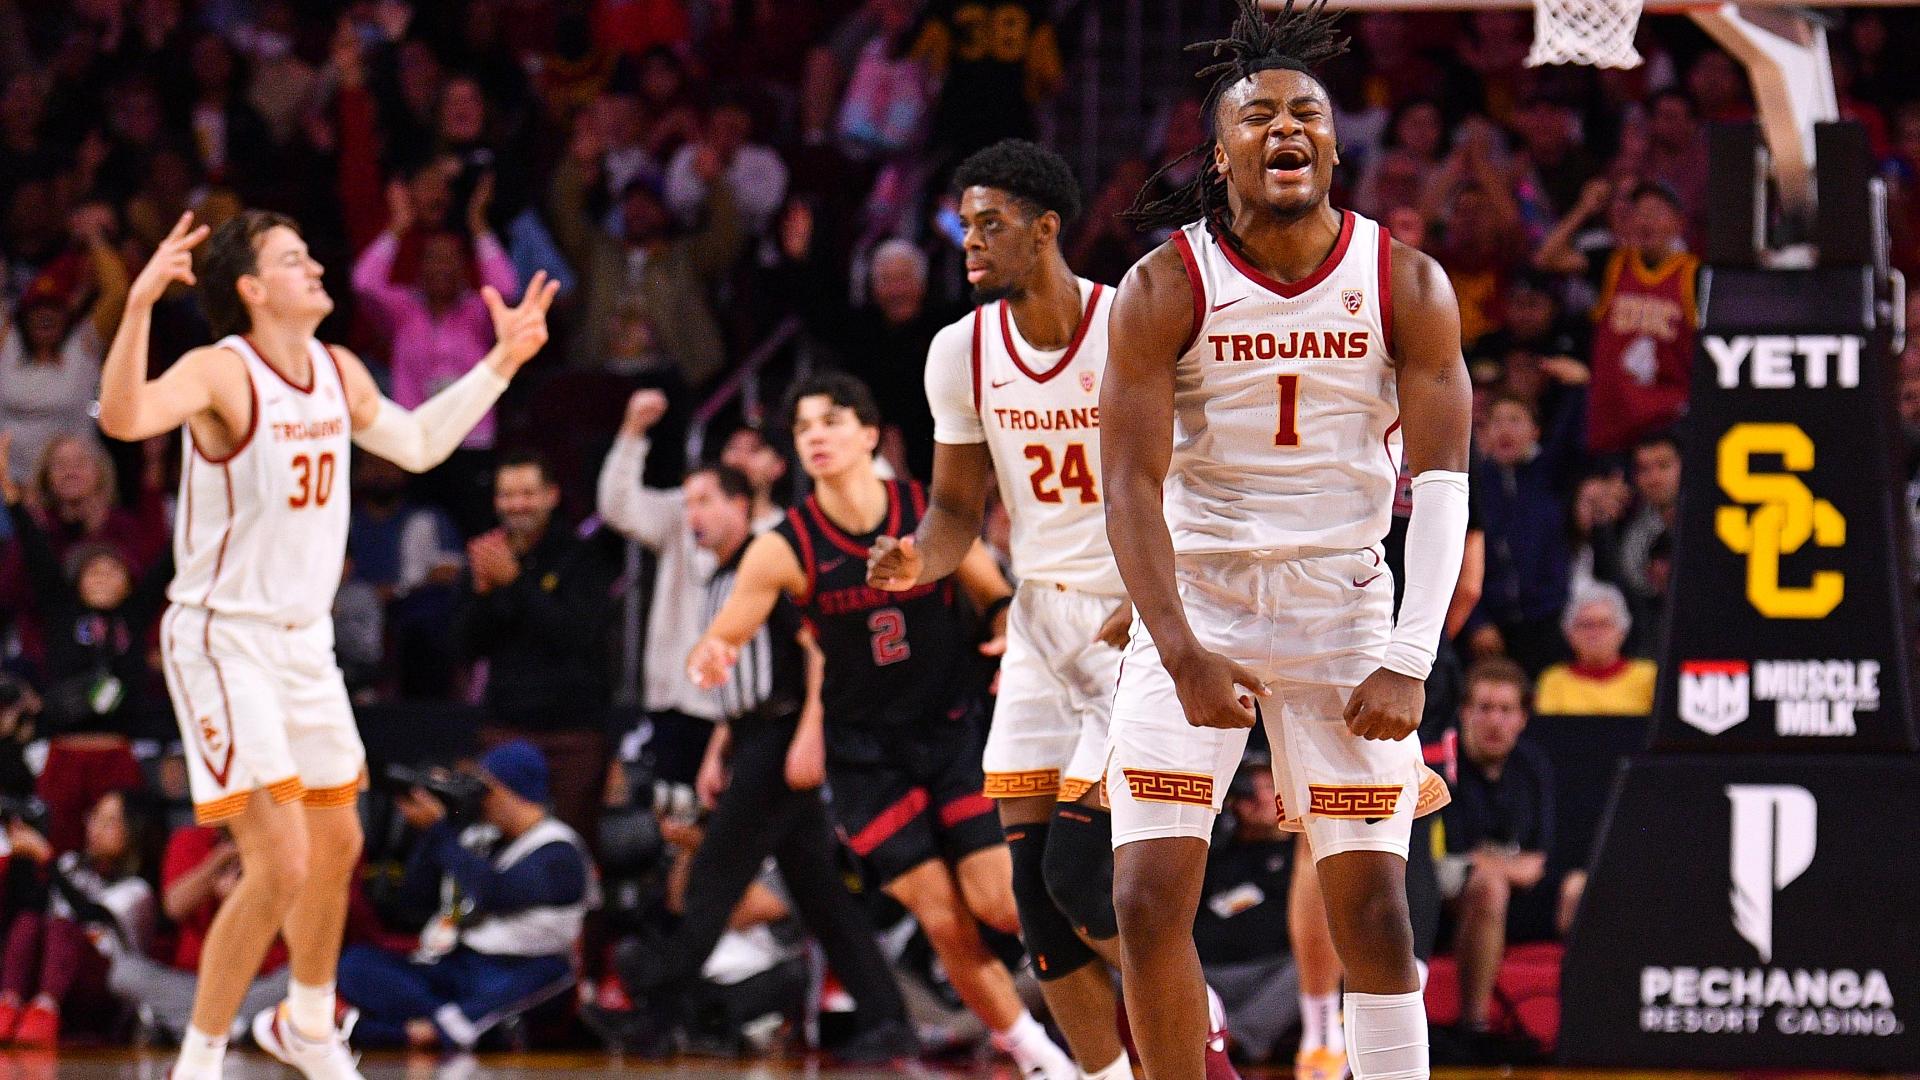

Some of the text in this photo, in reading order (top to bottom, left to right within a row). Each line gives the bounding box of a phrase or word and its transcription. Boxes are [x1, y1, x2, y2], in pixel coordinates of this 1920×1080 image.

[1208, 332, 1369, 361] TROJANS
[1702, 335, 1862, 389] YETI
[993, 407, 1100, 431] TROJANS
[1275, 374, 1300, 447] 1
[288, 452, 336, 508] 30
[1023, 443, 1099, 504] 24
[868, 608, 911, 666] 2
[1752, 659, 1880, 701] MUSCLE
[1775, 699, 1856, 736] MILK
[1641, 966, 1894, 1008] PECHANGA
[1640, 1007, 1764, 1034] RESORT
